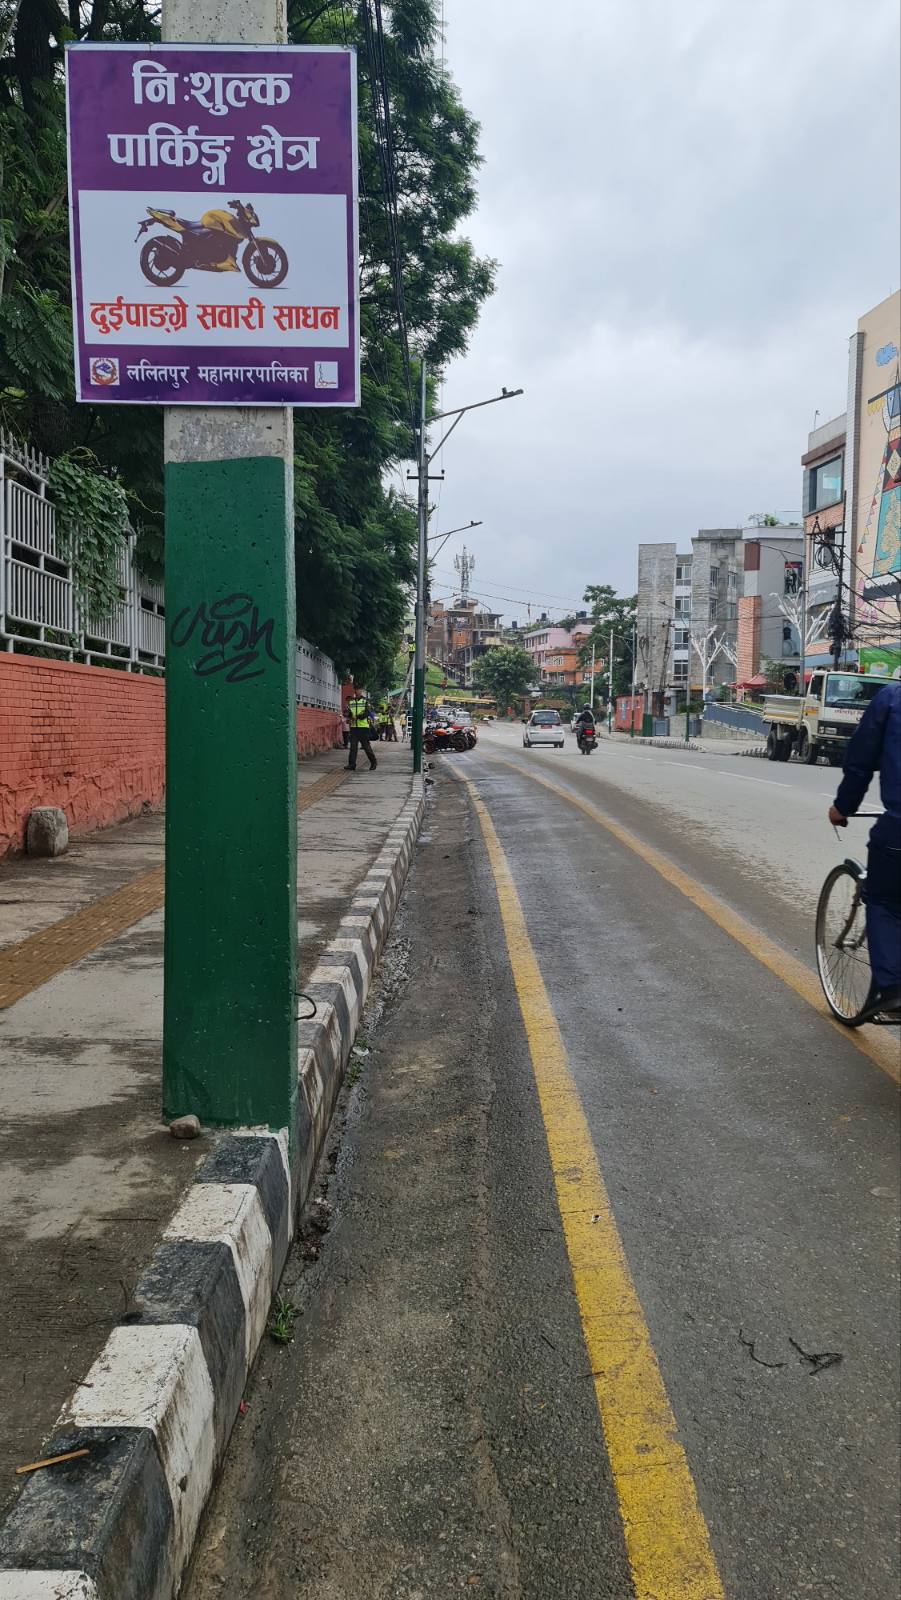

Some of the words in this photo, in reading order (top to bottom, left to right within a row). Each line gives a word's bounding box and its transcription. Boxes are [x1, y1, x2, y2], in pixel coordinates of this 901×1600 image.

[107, 122, 235, 185] पार्किङ्ग
[246, 124, 320, 174] क्षेत्र
[196, 297, 266, 331] सवारी
[273, 305, 341, 331] साधन
[126, 358, 190, 388] ललितपुर
[197, 360, 309, 386] महानगरपालिका
